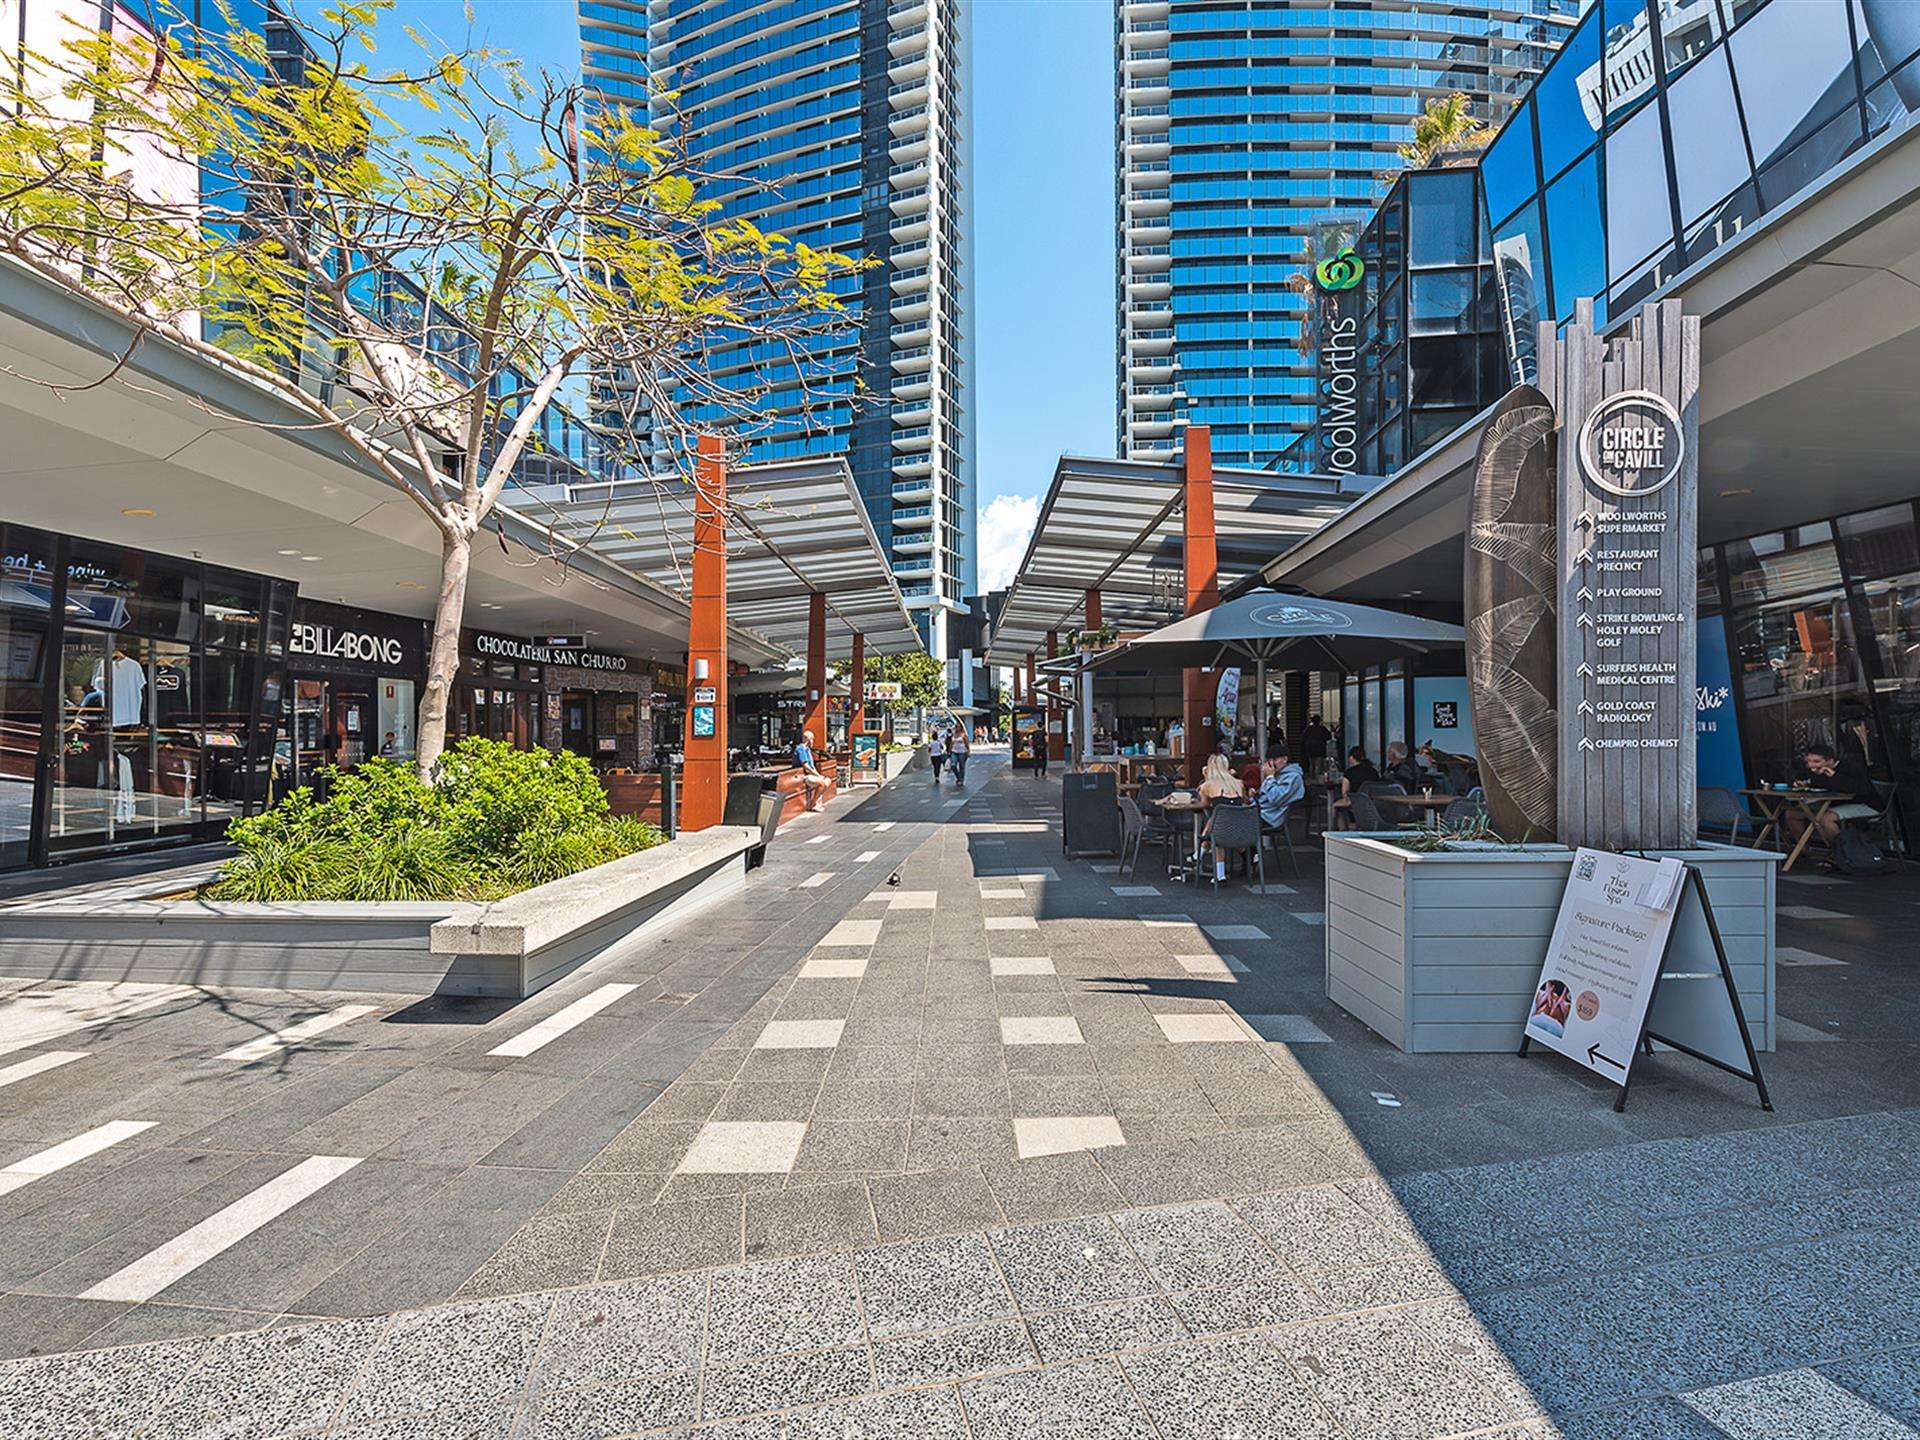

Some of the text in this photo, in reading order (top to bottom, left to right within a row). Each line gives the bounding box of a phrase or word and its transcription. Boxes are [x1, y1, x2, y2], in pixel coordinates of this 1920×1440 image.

[1603, 427, 1665, 449] CIRCLE
[1614, 450, 1665, 468] CAVILL
[1597, 511, 1667, 521] WOOLWORTHS
[1597, 524, 1666, 533] SUPERMARKET
[1597, 549, 1659, 559] RESTAURANT
[1597, 562, 1642, 571] PRECINCT
[1597, 587, 1662, 597] PLAYGROUND
[1597, 613, 1685, 622] STRIKE BOWLING &
[1597, 625, 1662, 635] HOLEY MOLEY
[303, 625, 402, 664] BILLABONG
[1597, 638, 1621, 647] GOLF
[477, 635, 551, 663] CHOCOLATERIA
[554, 650, 578, 665] SAN
[581, 653, 627, 671] CHURRO
[1597, 663, 1676, 672] SURFERS HEALTH
[1597, 675, 1676, 685] MEDICAL CENTRE
[1596, 701, 1656, 711] GOLD COAST
[1597, 713, 1652, 722] RADIOLOGY
[1596, 738, 1679, 748] CHEMPRO CHEMIST
[1610, 874, 1629, 888] Thai
[1574, 912, 1648, 942] Signature Package
